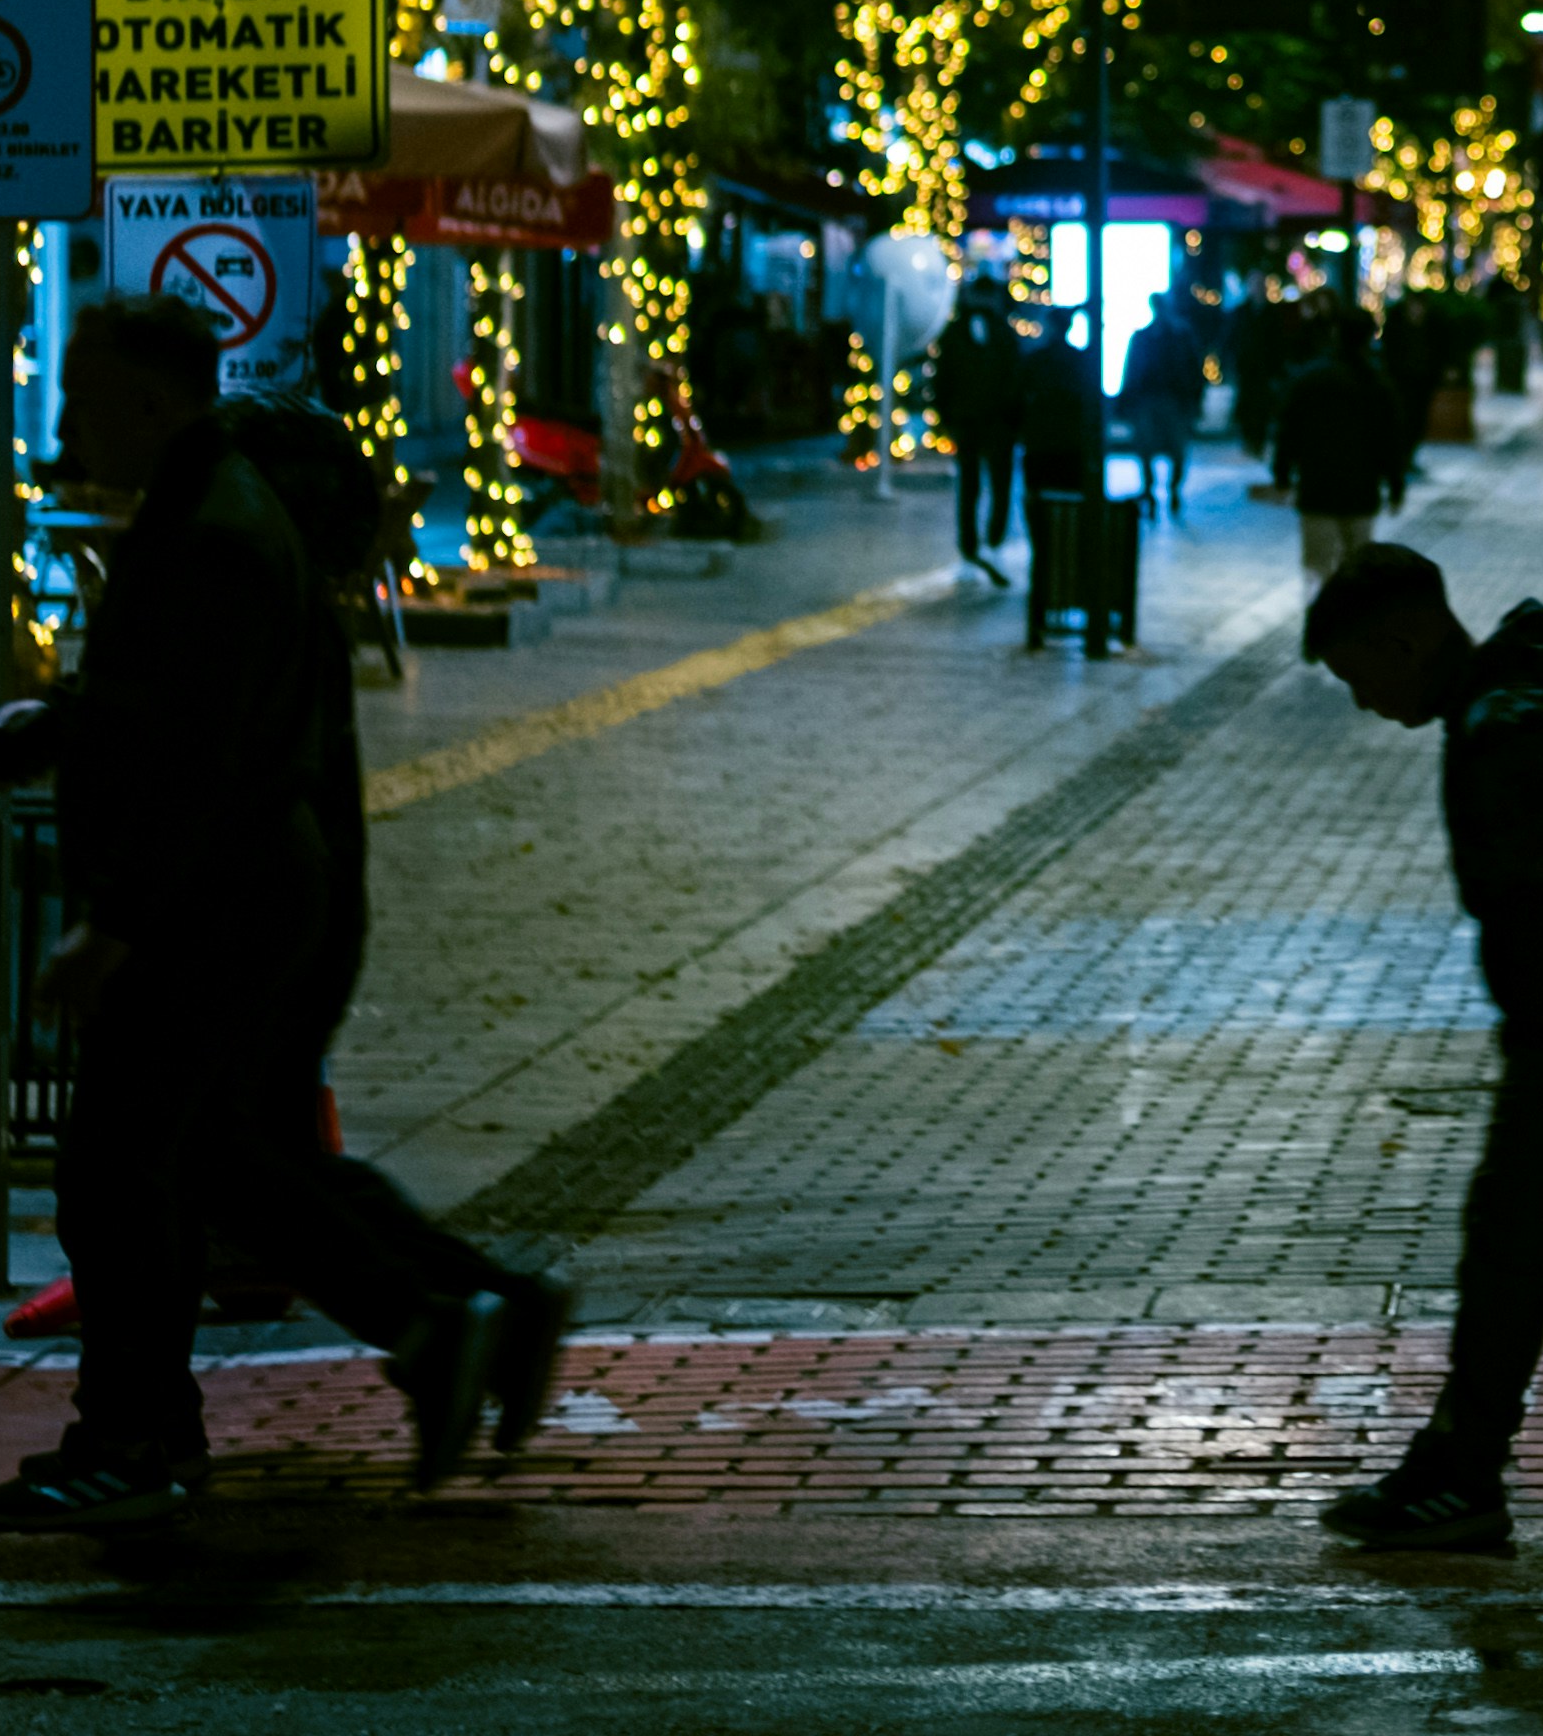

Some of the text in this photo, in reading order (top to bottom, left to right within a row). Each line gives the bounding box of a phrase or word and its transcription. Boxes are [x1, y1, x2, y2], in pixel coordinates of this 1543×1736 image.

[97, 8, 346, 54] OTOMATİK
[114, 109, 328, 154] BARİYER
[118, 194, 190, 219] YAYA
[200, 190, 307, 218] BÖLGESİ
